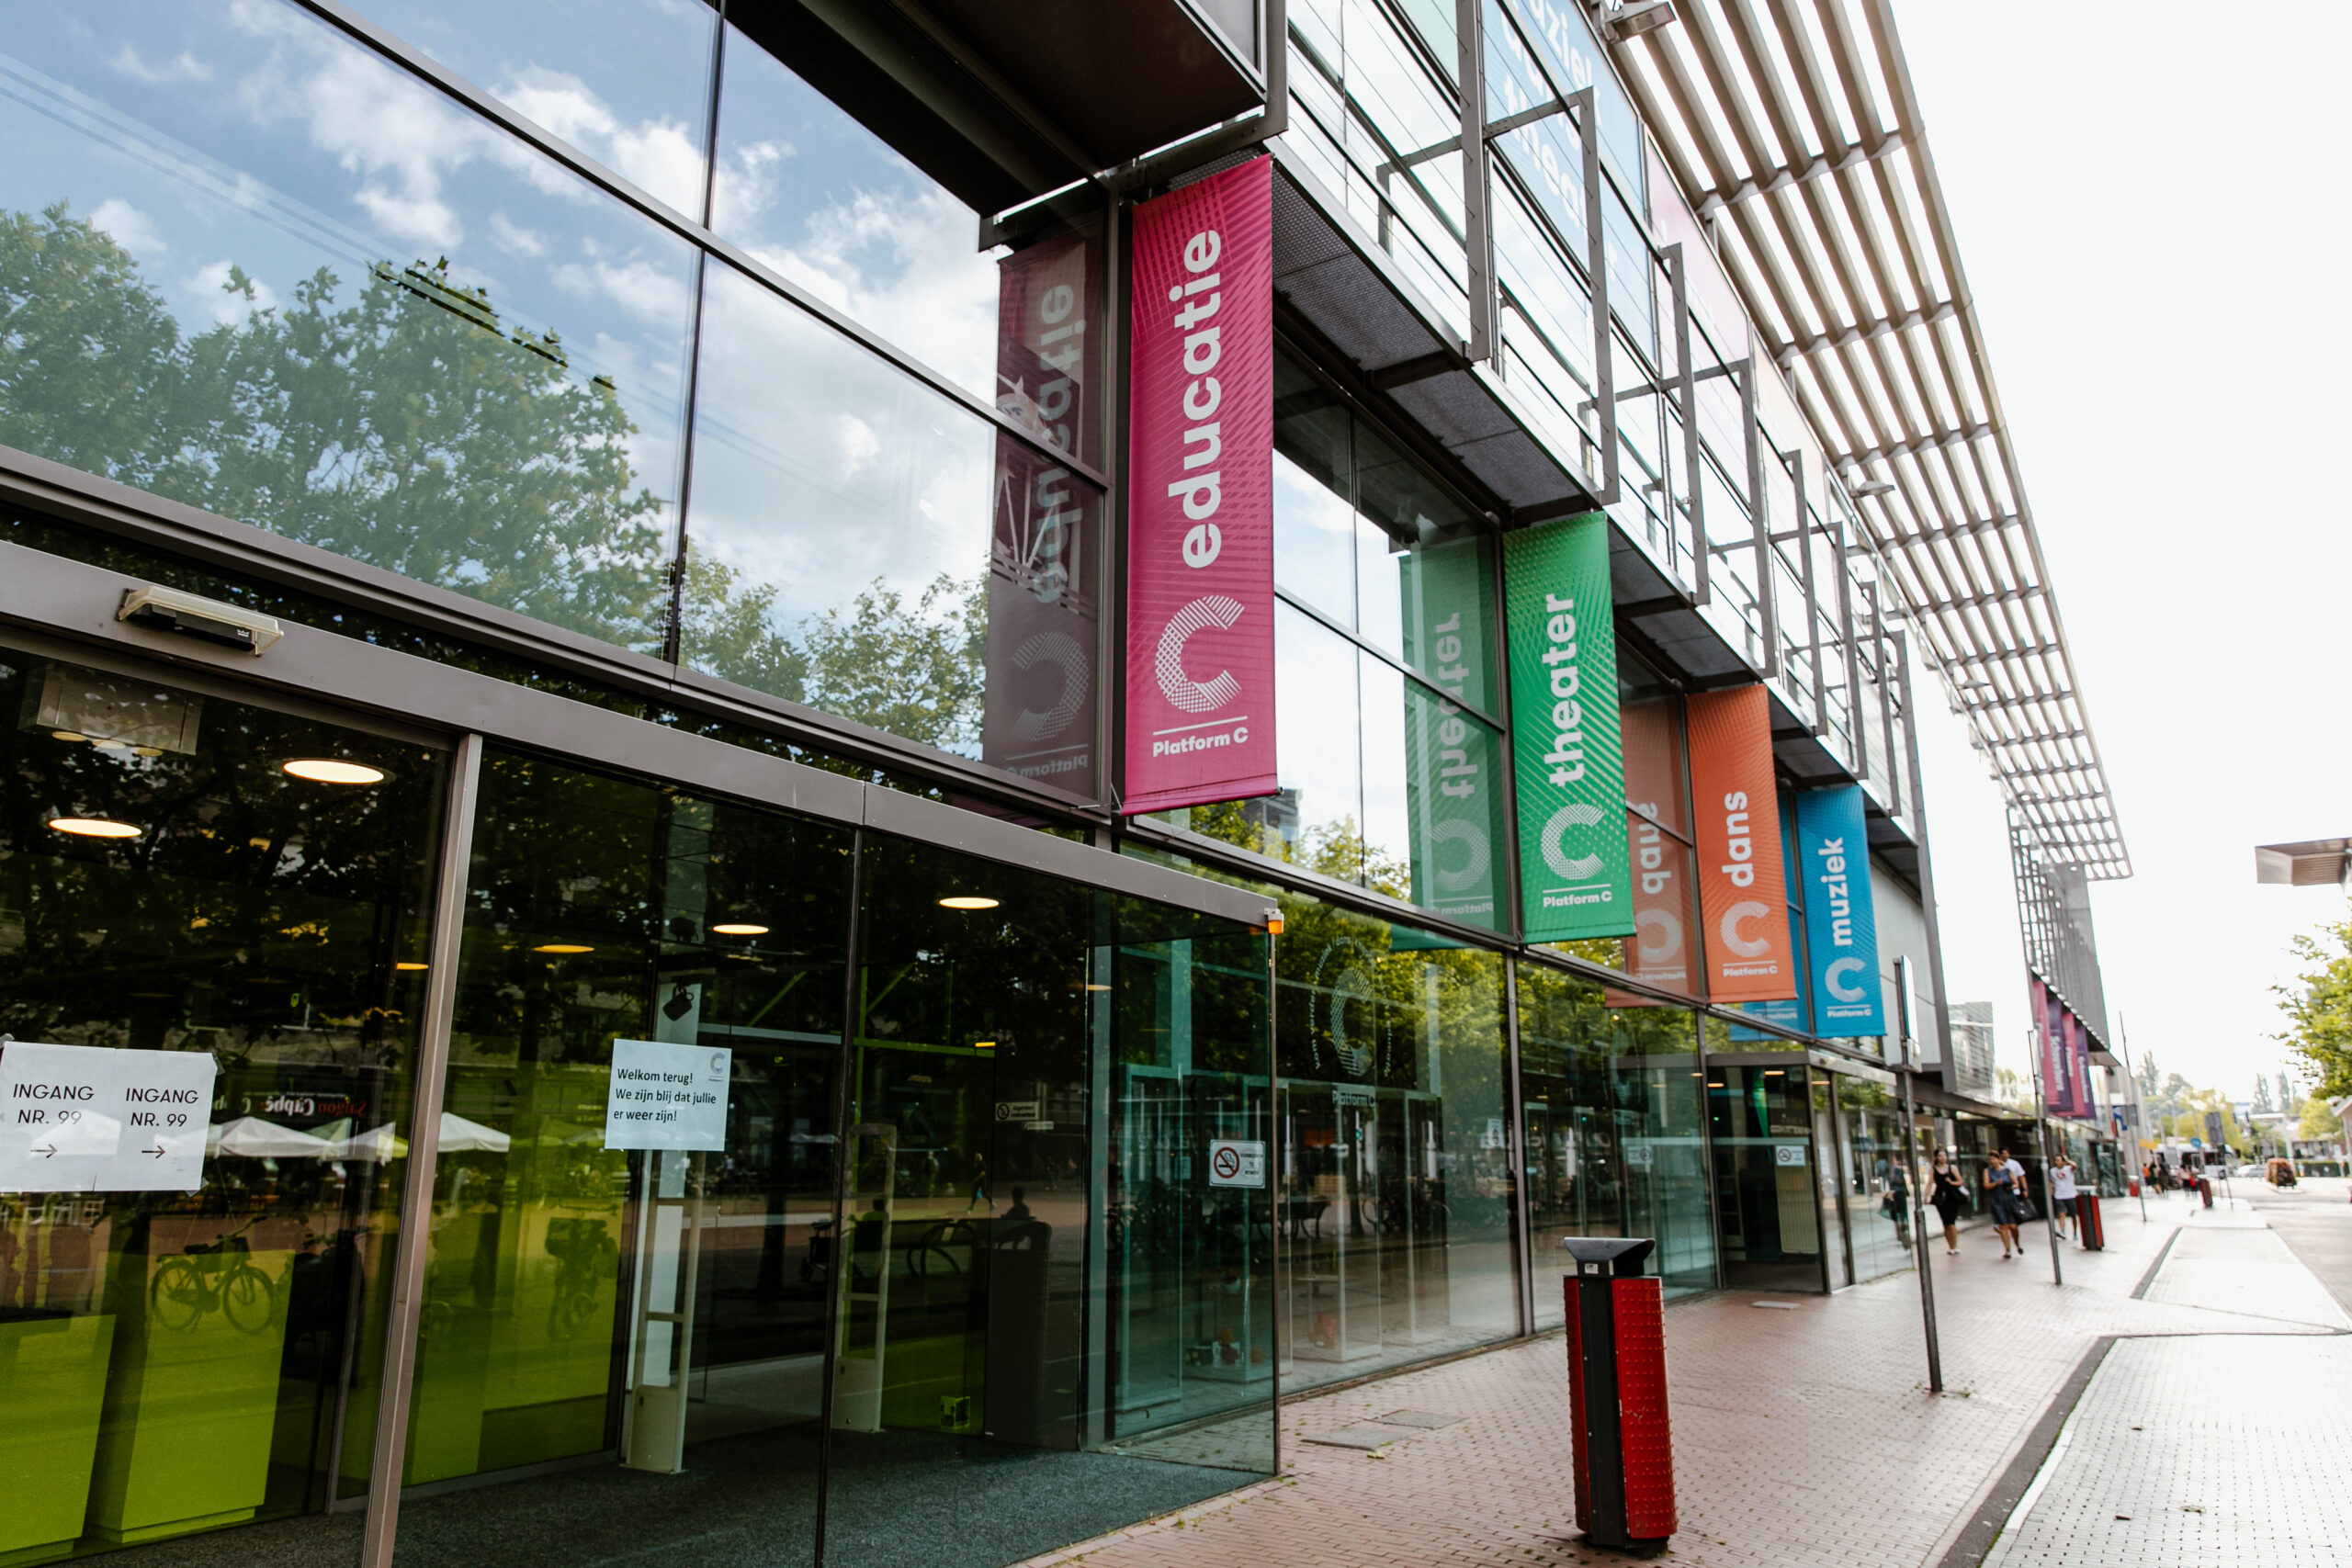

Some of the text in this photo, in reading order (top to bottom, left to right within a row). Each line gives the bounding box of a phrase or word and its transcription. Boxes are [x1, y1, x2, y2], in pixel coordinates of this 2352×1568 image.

[1169, 230, 1221, 569] educatie
[1543, 592, 1585, 788] theater
[1152, 728, 1249, 758] Platform C
[1722, 791, 1754, 887] dans
[1543, 891, 1612, 908] Platform C
[1818, 837, 1854, 947] muziek
[1723, 964, 1779, 977] Platform C
[1826, 1010, 1863, 1019] Platform
[617, 1068, 694, 1086] Welkom terug!
[13, 1084, 95, 1100] INGANG
[126, 1088, 198, 1104] INGANG
[616, 1089, 717, 1106] We zijn blij dat jullie
[17, 1110, 83, 1124] NR. 99
[130, 1112, 187, 1127] NR. 99
[614, 1111, 624, 1120] er
[626, 1111, 653, 1121] weer
[655, 1110, 677, 1123] zijn!
